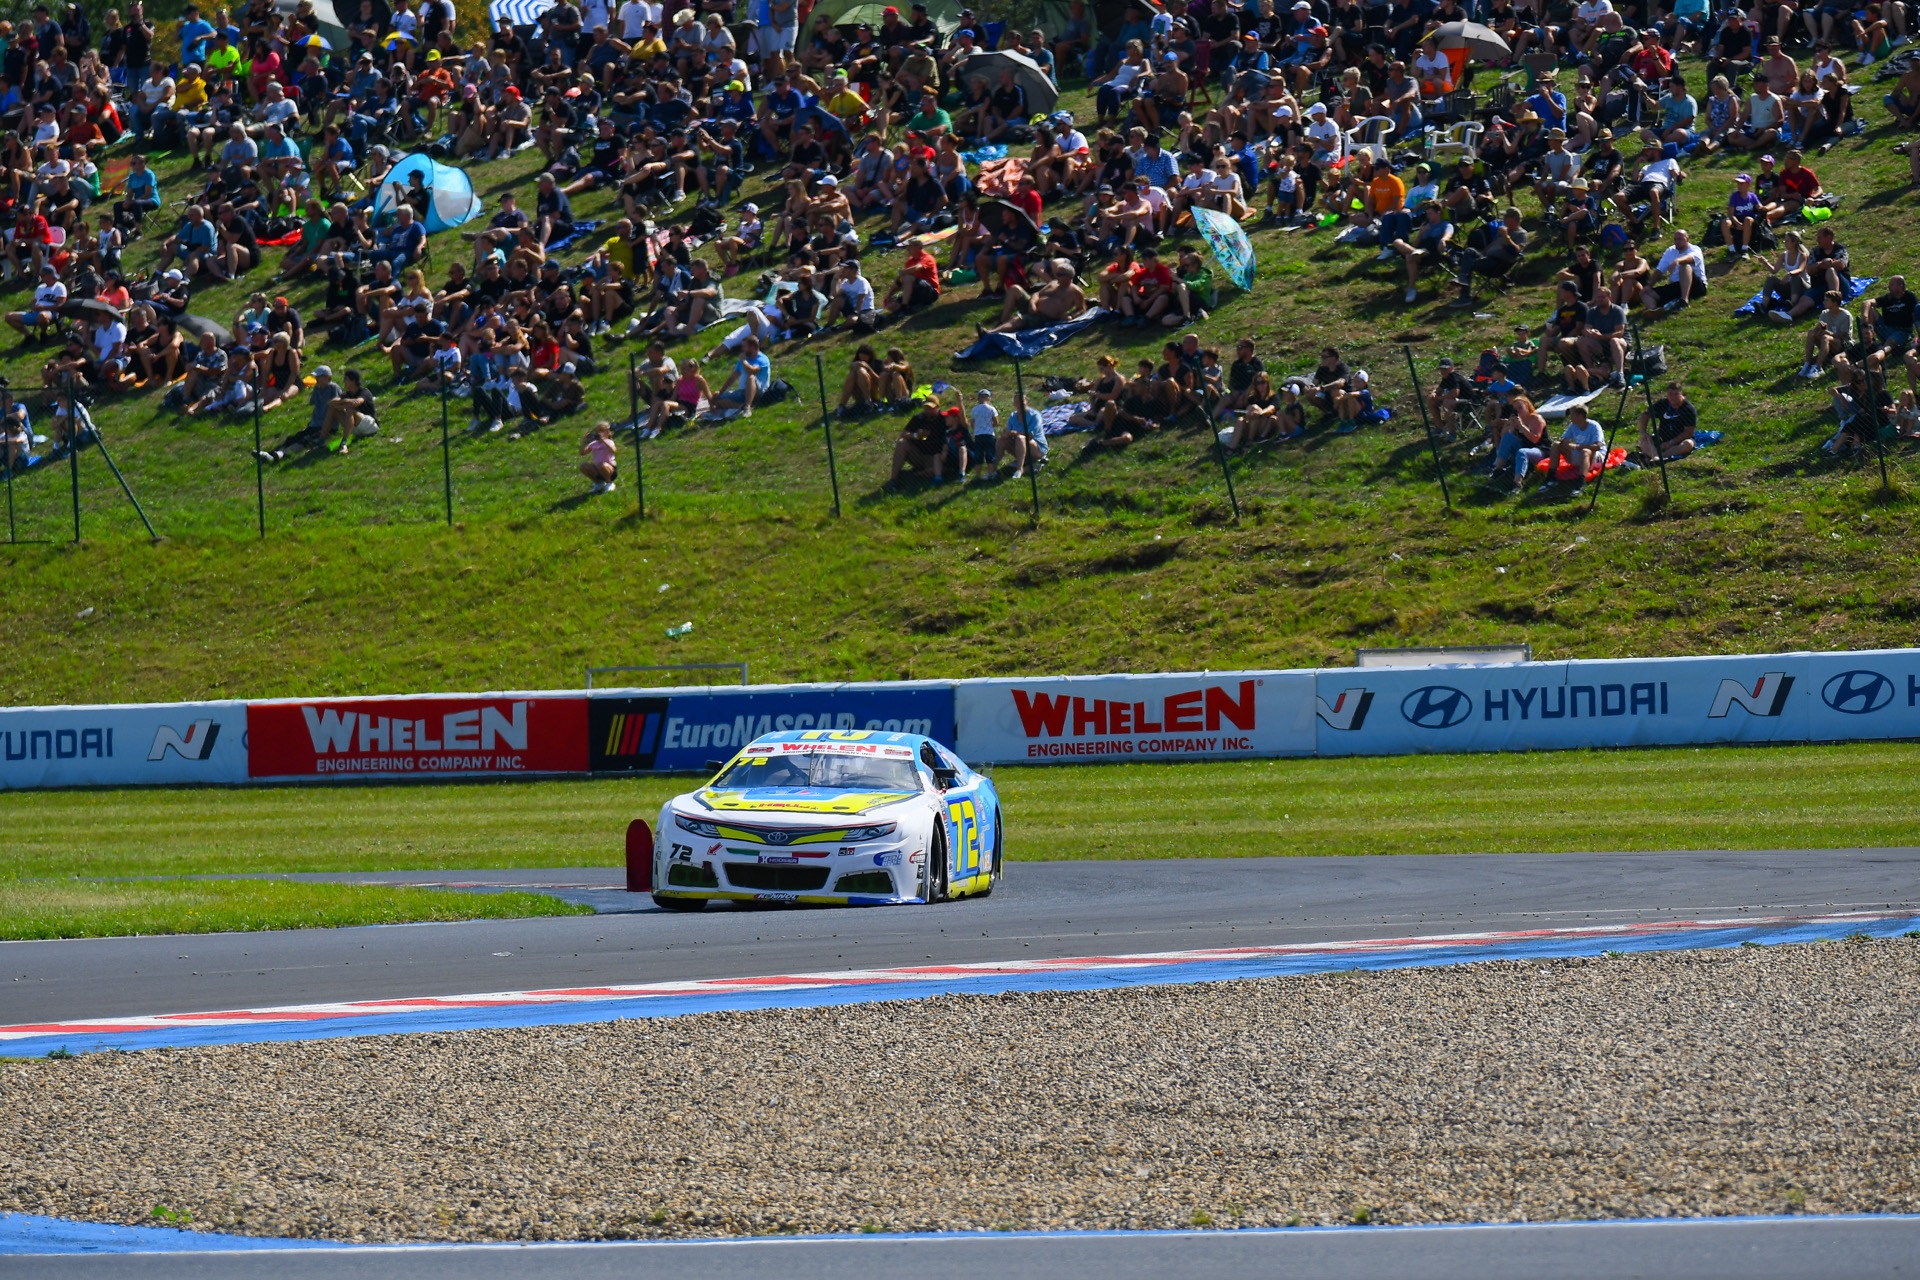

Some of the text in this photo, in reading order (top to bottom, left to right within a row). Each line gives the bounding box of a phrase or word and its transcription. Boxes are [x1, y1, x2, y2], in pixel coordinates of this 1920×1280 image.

[1011, 679, 1256, 738] WHELEN
[1484, 681, 1669, 722] HYUNDAI
[301, 701, 529, 753] WHELEN
[663, 711, 932, 749] EuroNASCARcom
[736, 757, 769, 767] 72
[782, 743, 878, 753] WHELEN
[1027, 736, 1255, 758] ENGINEERING COMPANY INC.
[316, 755, 526, 773] ENGINEERING COMPANY INC.
[948, 798, 979, 876] 72
[669, 843, 693, 862] 72
